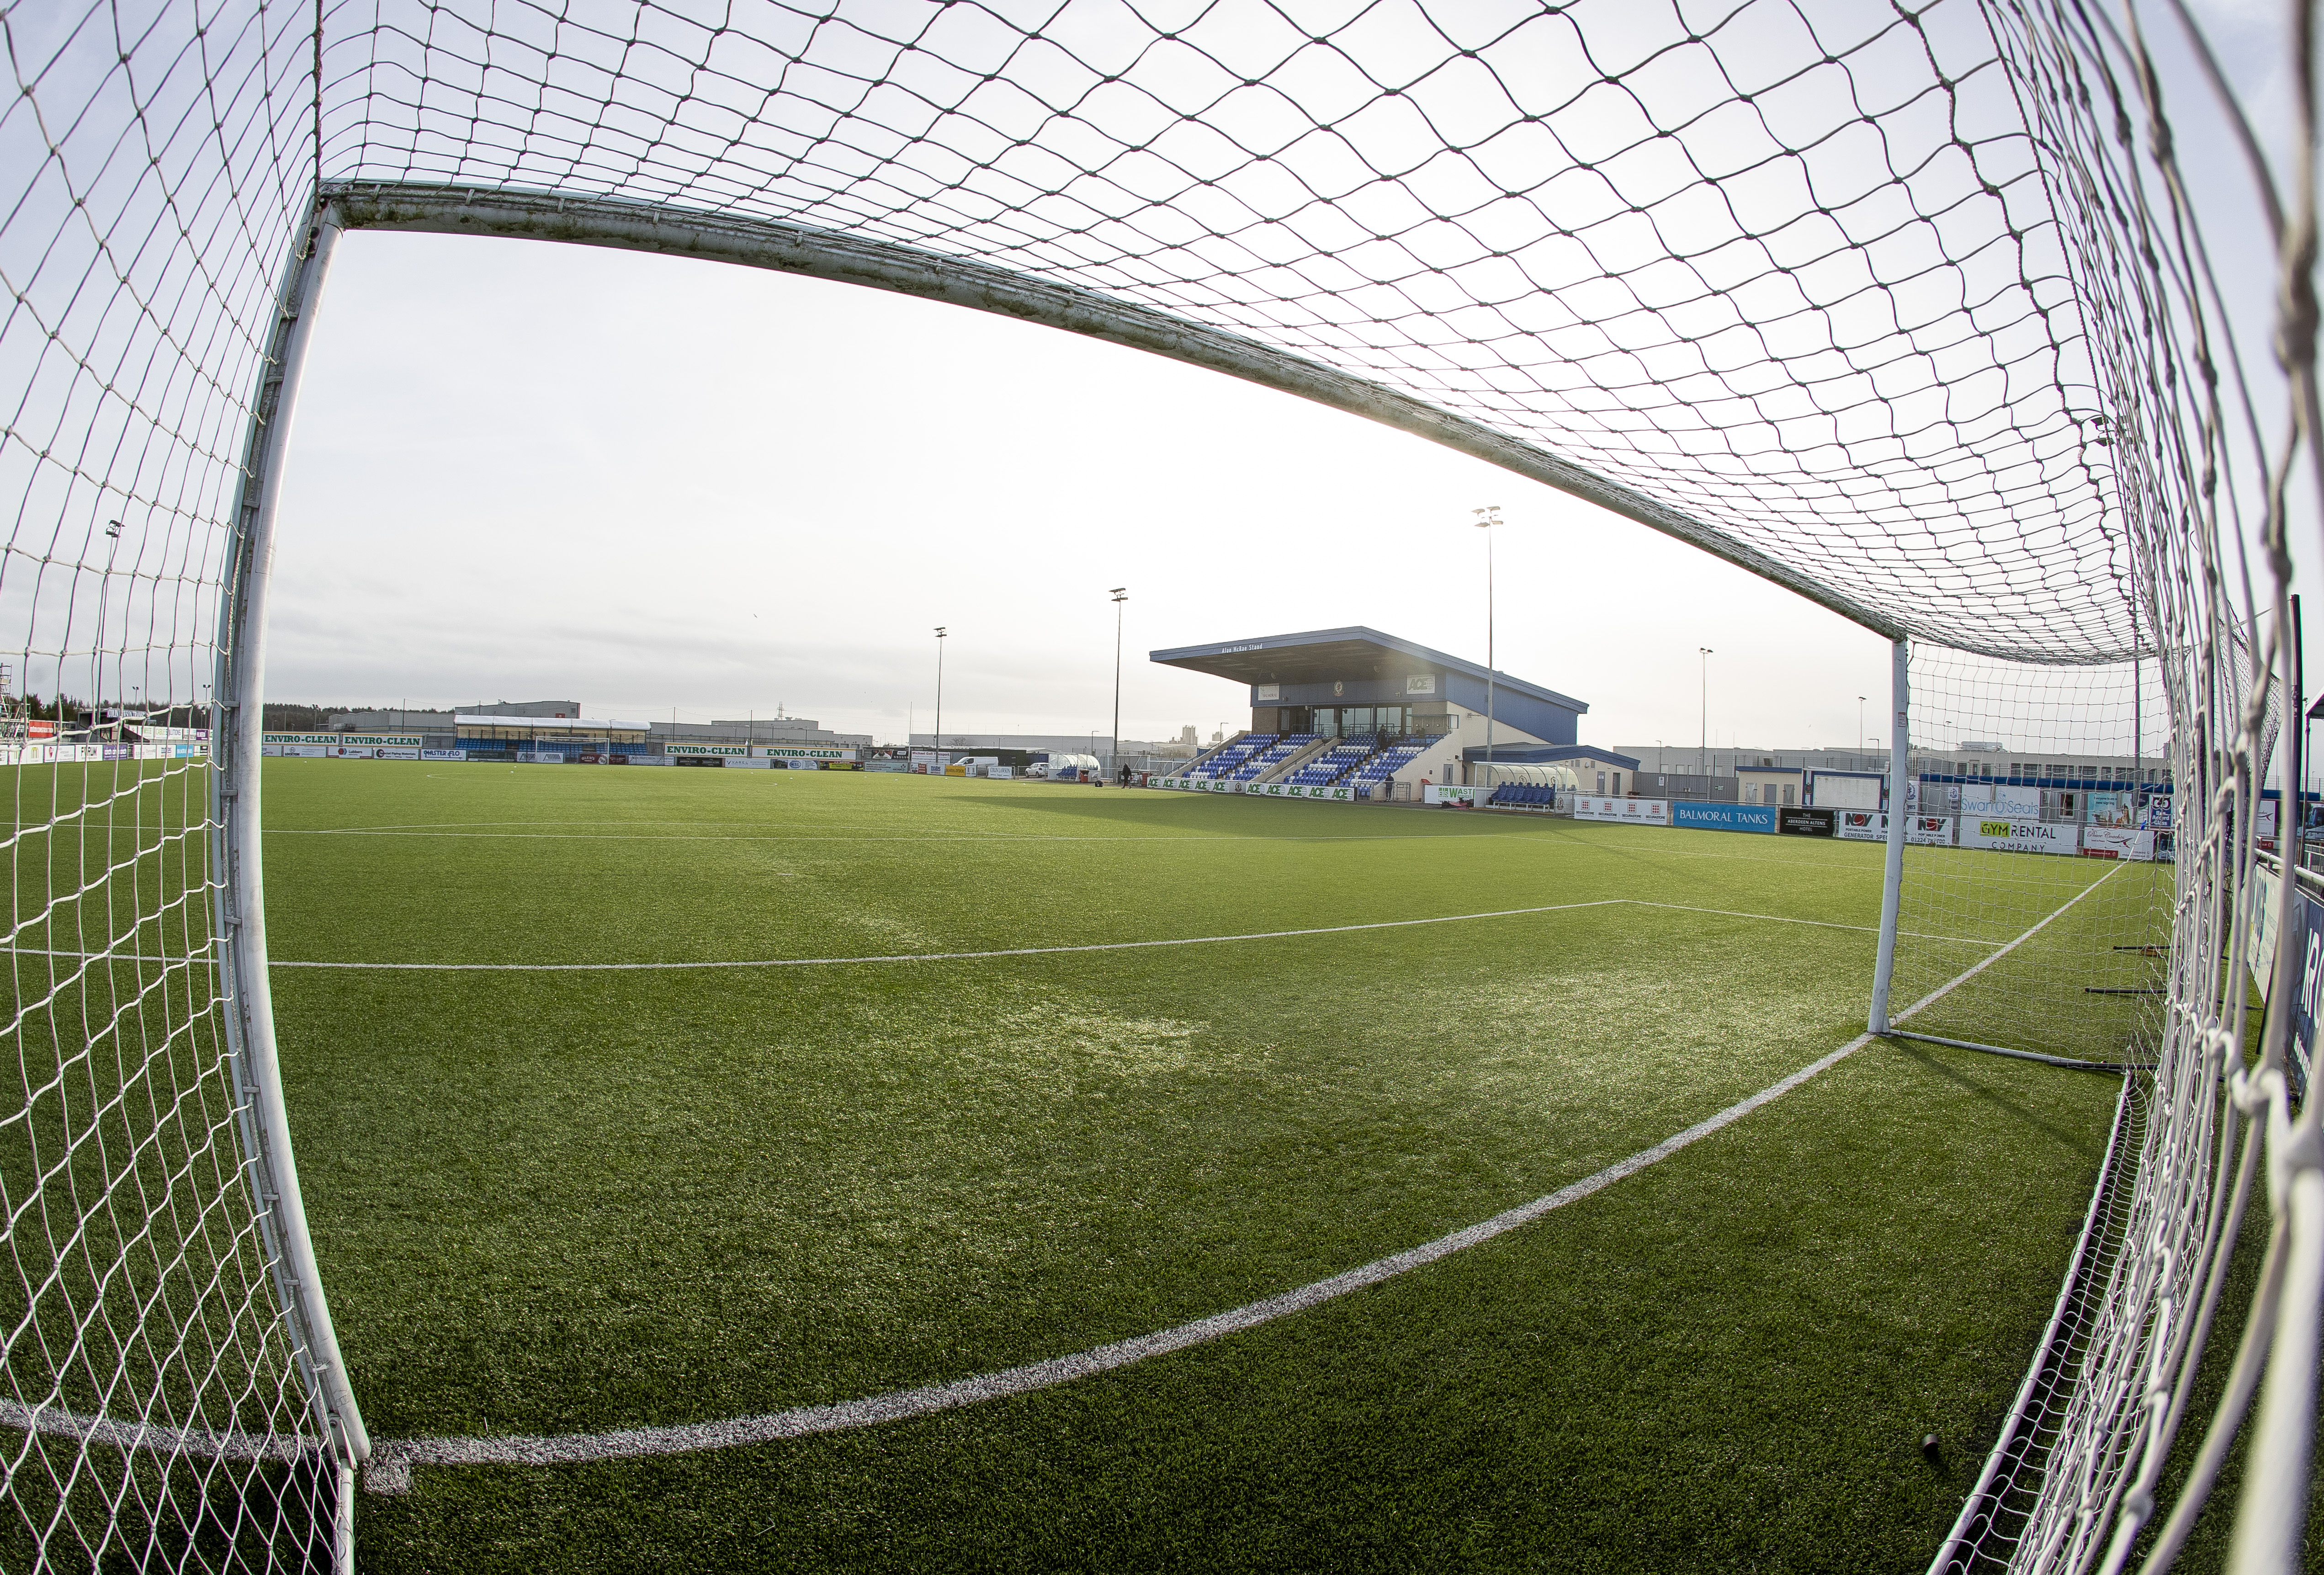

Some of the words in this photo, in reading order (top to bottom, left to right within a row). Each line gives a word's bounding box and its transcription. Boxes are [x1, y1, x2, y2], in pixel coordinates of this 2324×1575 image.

[1407, 678, 1428, 691] ACE
[265, 735, 337, 744] ENVIRO-CLEAN
[344, 736, 420, 745] ENVIRO-CLEAN
[666, 745, 745, 756] ENVIRO-CLEAN
[766, 749, 843, 758] ENVIRO-CLEAN
[1148, 778, 1158, 787] ACE
[1163, 779, 1174, 788] ACE
[1178, 780, 1190, 789] ACE
[1195, 781, 1207, 790] ACE
[1213, 782, 1225, 791] ACE
[1247, 783, 1260, 793] ACE
[1267, 784, 1280, 795] ACE
[1287, 786, 1302, 796] ACE
[1309, 787, 1325, 798] ACE
[1449, 788, 1475, 798] WAST
[1332, 788, 1349, 799] ACE
[1961, 798, 1993, 812] Swan
[1680, 809, 1733, 822] BALMORAL
[1736, 813, 1768, 825] TANKS
[1845, 813, 1874, 827] NOV
[1917, 817, 1947, 832] NOV
[1981, 823, 2008, 836] GYM
[2011, 825, 2056, 839] RENTAL
[1991, 841, 2045, 852] COMPANY
